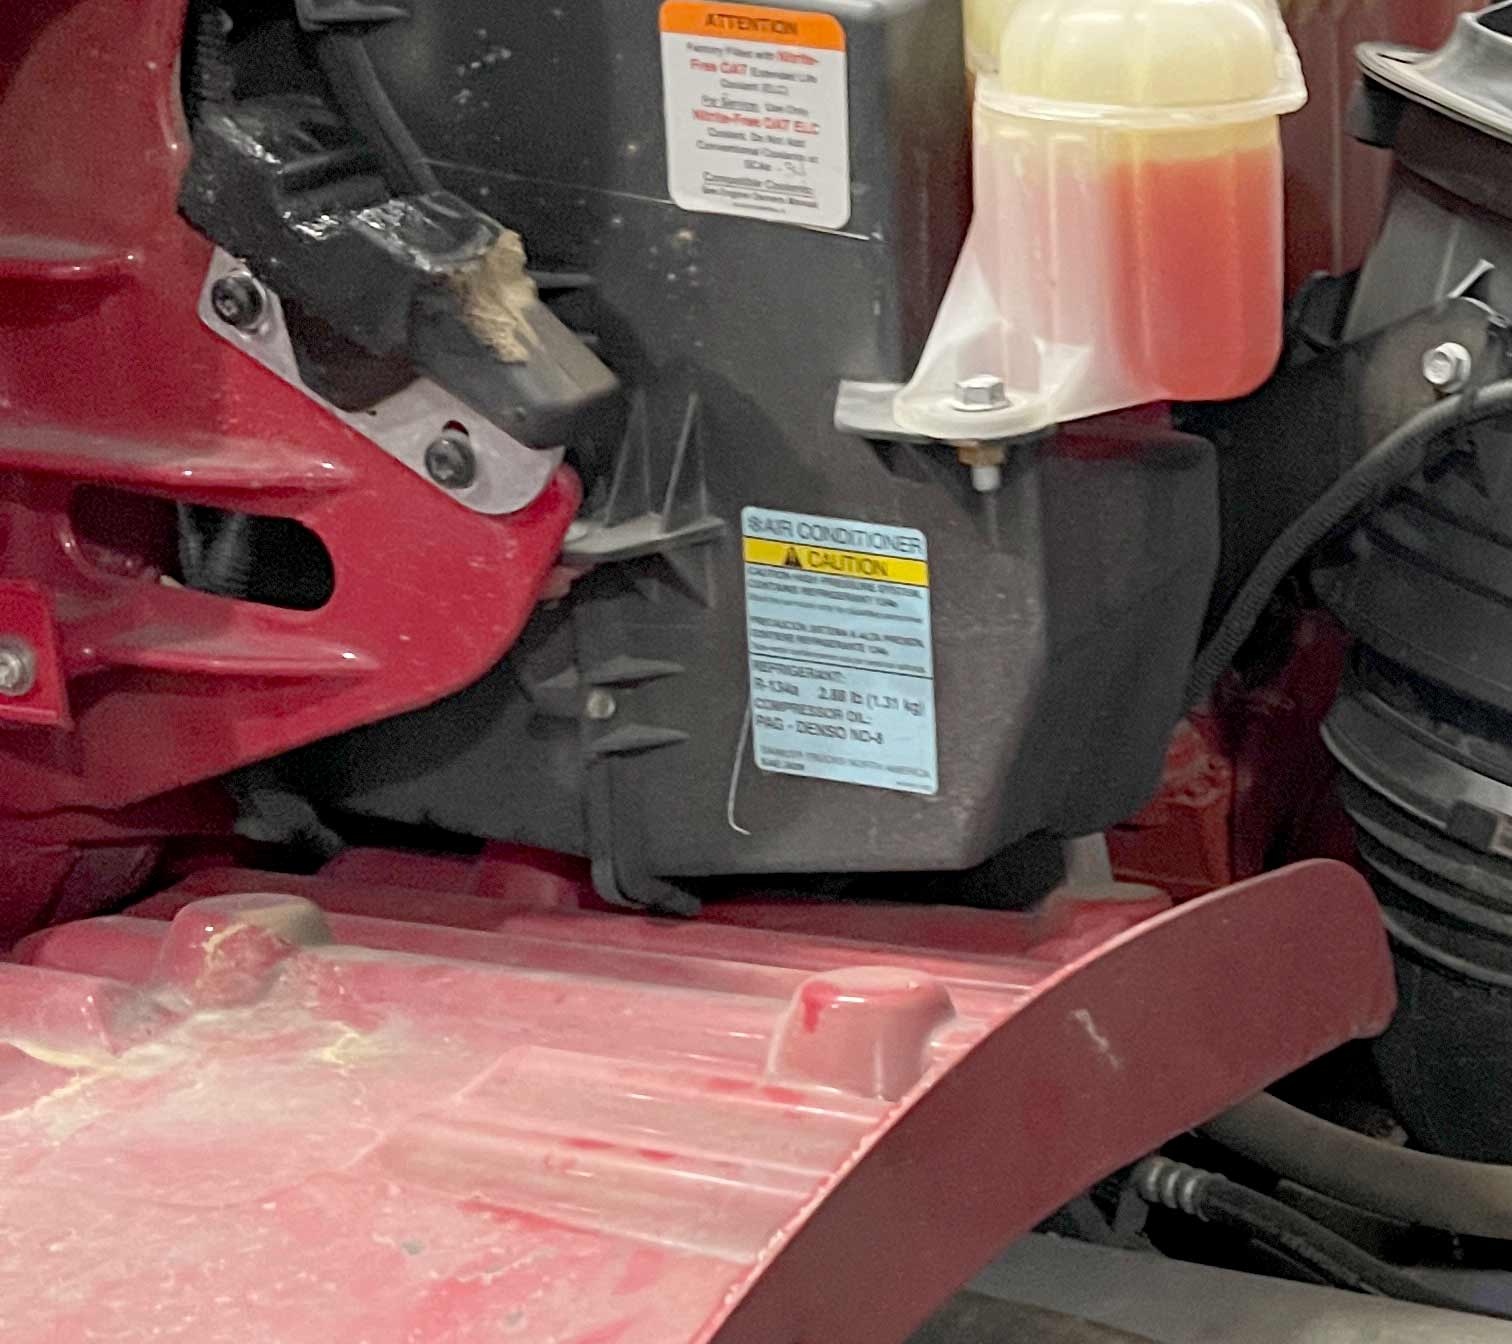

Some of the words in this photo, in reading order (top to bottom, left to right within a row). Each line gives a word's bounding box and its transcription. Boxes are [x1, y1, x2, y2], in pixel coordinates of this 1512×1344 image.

[705, 13, 796, 34] ATTENTION
[690, 58, 715, 71] Free
[765, 518, 792, 536] AIR
[797, 522, 920, 553] CONDITIONER
[807, 551, 887, 576] CAUTION
[753, 677, 798, 694] R-134a
[850, 692, 862, 704] lb
[903, 700, 925, 714] kg)
[754, 697, 842, 720] COMPRESSOR
[756, 714, 783, 730] PAG
[796, 720, 846, 739] DENSO
